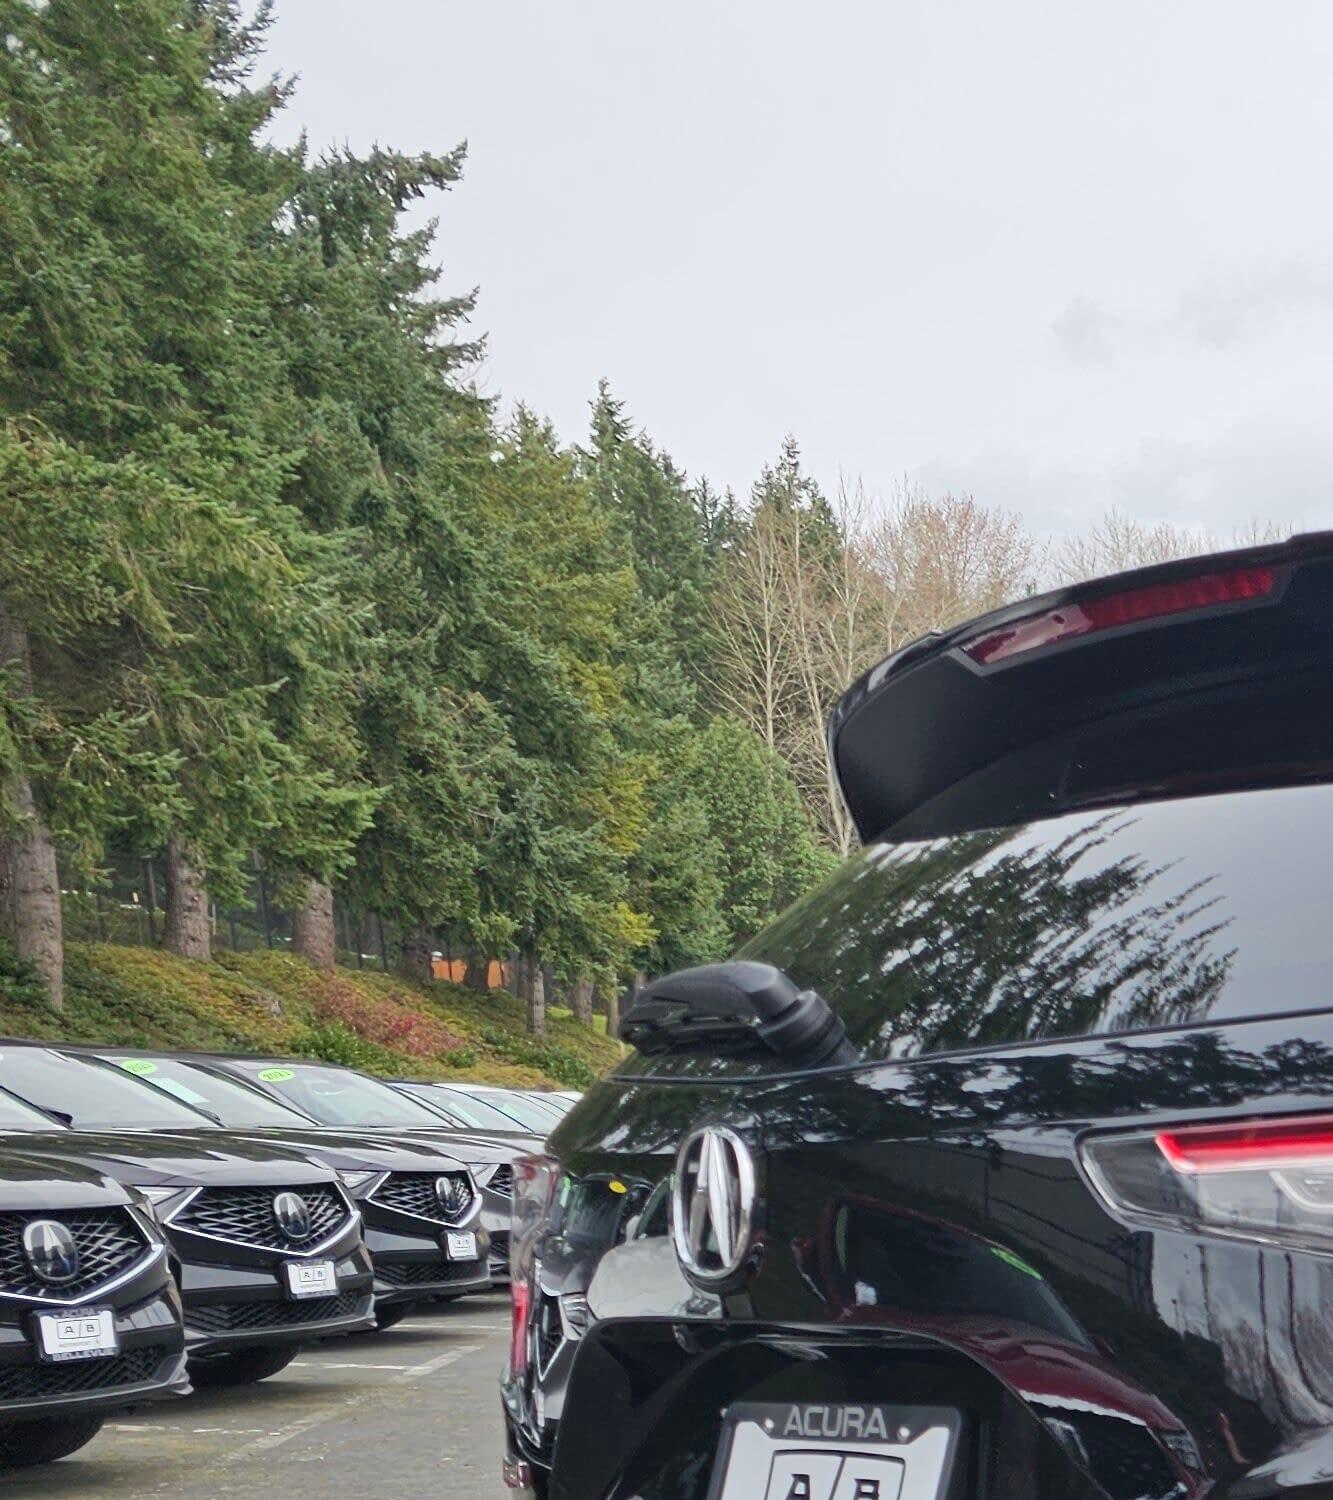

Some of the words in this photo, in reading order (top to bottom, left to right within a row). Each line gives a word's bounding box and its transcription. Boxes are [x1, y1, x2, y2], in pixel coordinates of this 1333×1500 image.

[65, 1326, 74, 1334] A
[86, 1324, 95, 1333] B
[783, 1405, 888, 1439] ACURA
